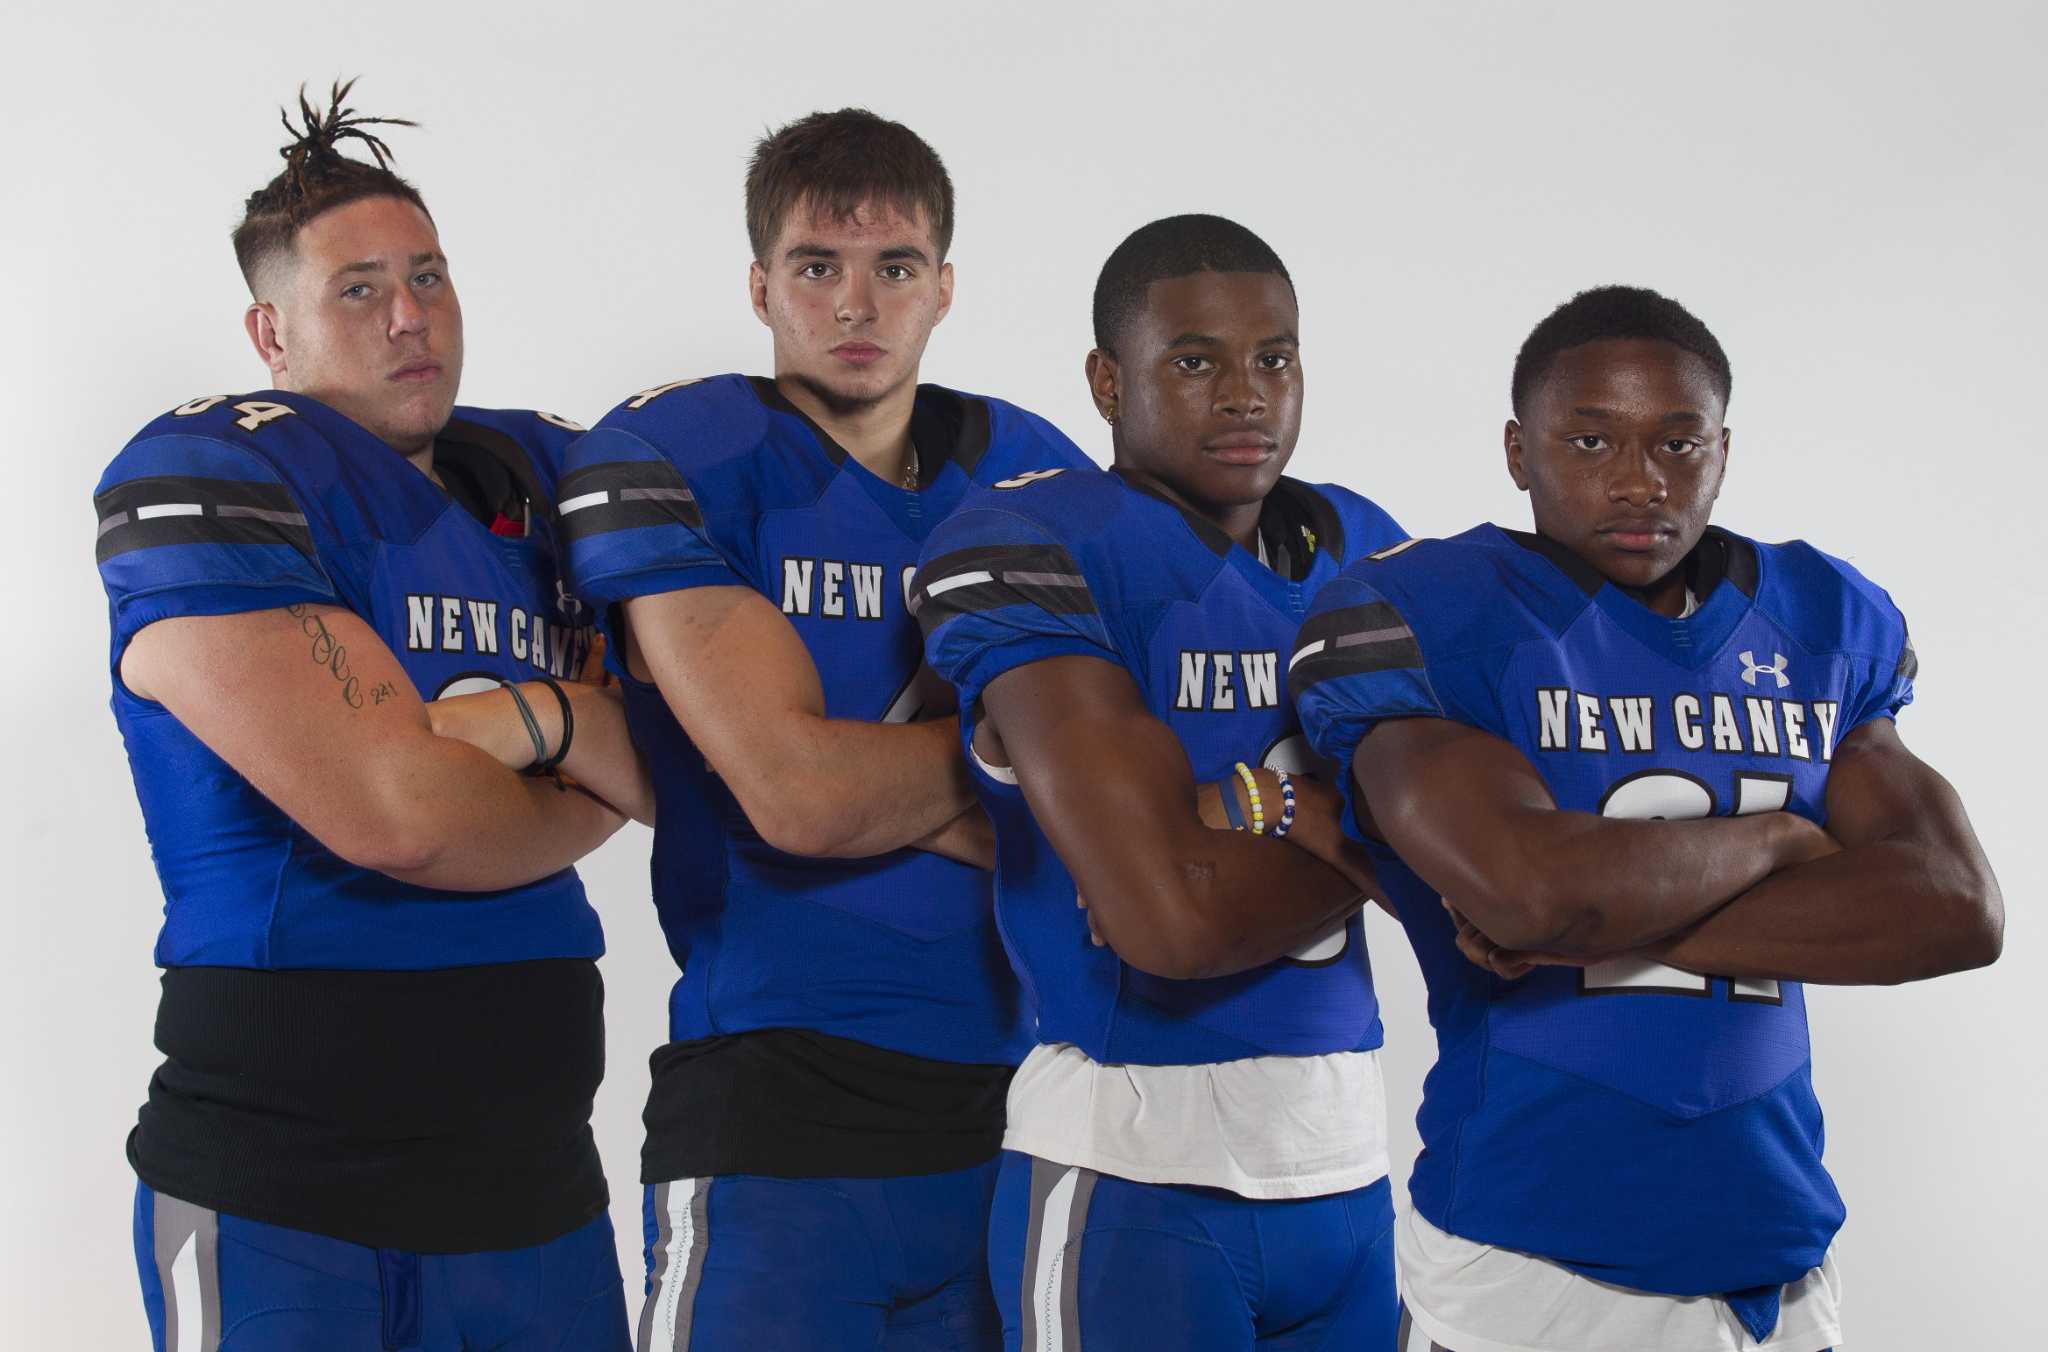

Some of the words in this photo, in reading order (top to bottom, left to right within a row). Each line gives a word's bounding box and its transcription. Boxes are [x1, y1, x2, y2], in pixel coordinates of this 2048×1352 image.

[784, 557, 884, 620] NEW
[406, 593, 499, 656] NEW
[1175, 650, 1280, 711] NEW
[1536, 687, 1656, 753] NEW
[1672, 692, 1838, 764] CANEY
